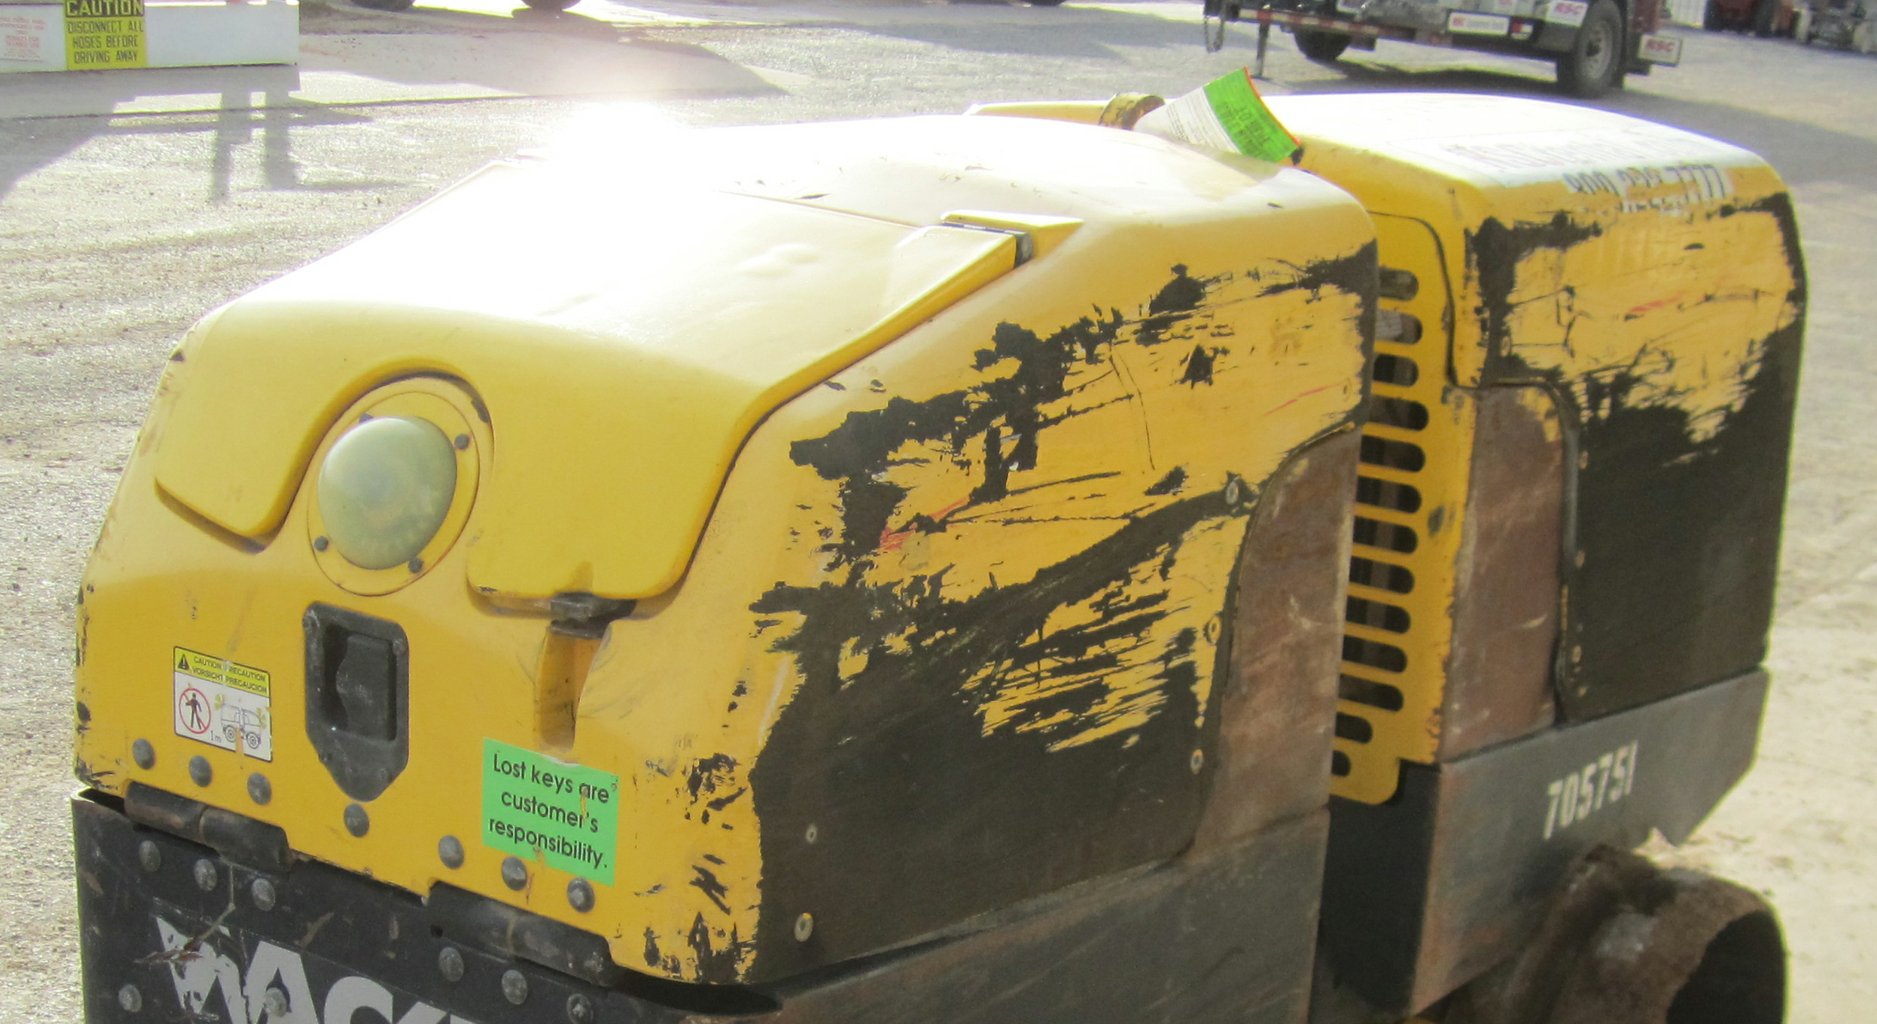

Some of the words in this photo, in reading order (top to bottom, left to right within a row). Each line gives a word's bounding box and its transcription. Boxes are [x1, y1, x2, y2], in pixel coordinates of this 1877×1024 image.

[66, 0, 144, 16] CAUTION
[67, 21, 122, 34] DISCONNECT
[128, 20, 144, 32] ALL
[73, 35, 101, 48] HOSES
[106, 34, 138, 47] BEFORE
[74, 50, 110, 63] DRIVING
[116, 50, 137, 61] AWAY
[194, 656, 223, 670] CAUTION
[193, 667, 224, 681] VORSICHT
[493, 751, 527, 780] Lost
[531, 764, 573, 794] keys
[578, 782, 610, 804] are
[1544, 740, 1639, 840] 705751
[501, 791, 599, 833] customer's
[489, 818, 608, 869] responsibility.
